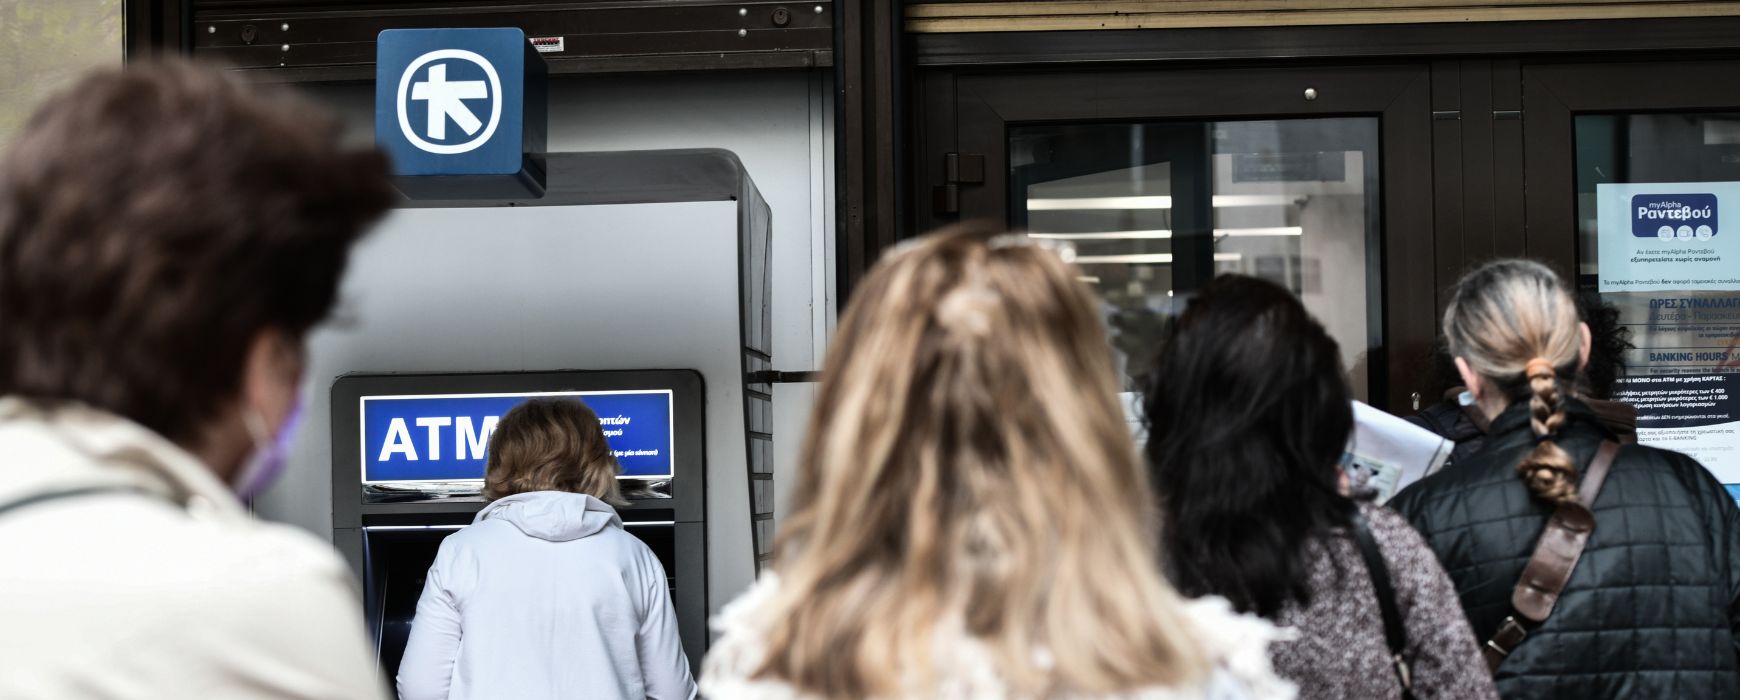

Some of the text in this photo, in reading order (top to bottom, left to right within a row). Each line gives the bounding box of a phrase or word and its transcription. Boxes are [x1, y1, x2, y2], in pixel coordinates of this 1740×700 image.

[1638, 206, 1711, 221] Ραντεβού
[1650, 298, 1740, 309] ΩΡΕΣ ΣΥΝΑΛΛΑΓ
[1650, 352, 1693, 361] BANKING
[1696, 352, 1728, 361] HOURS
[602, 428, 623, 437] σμού
[378, 415, 500, 462] ATM
